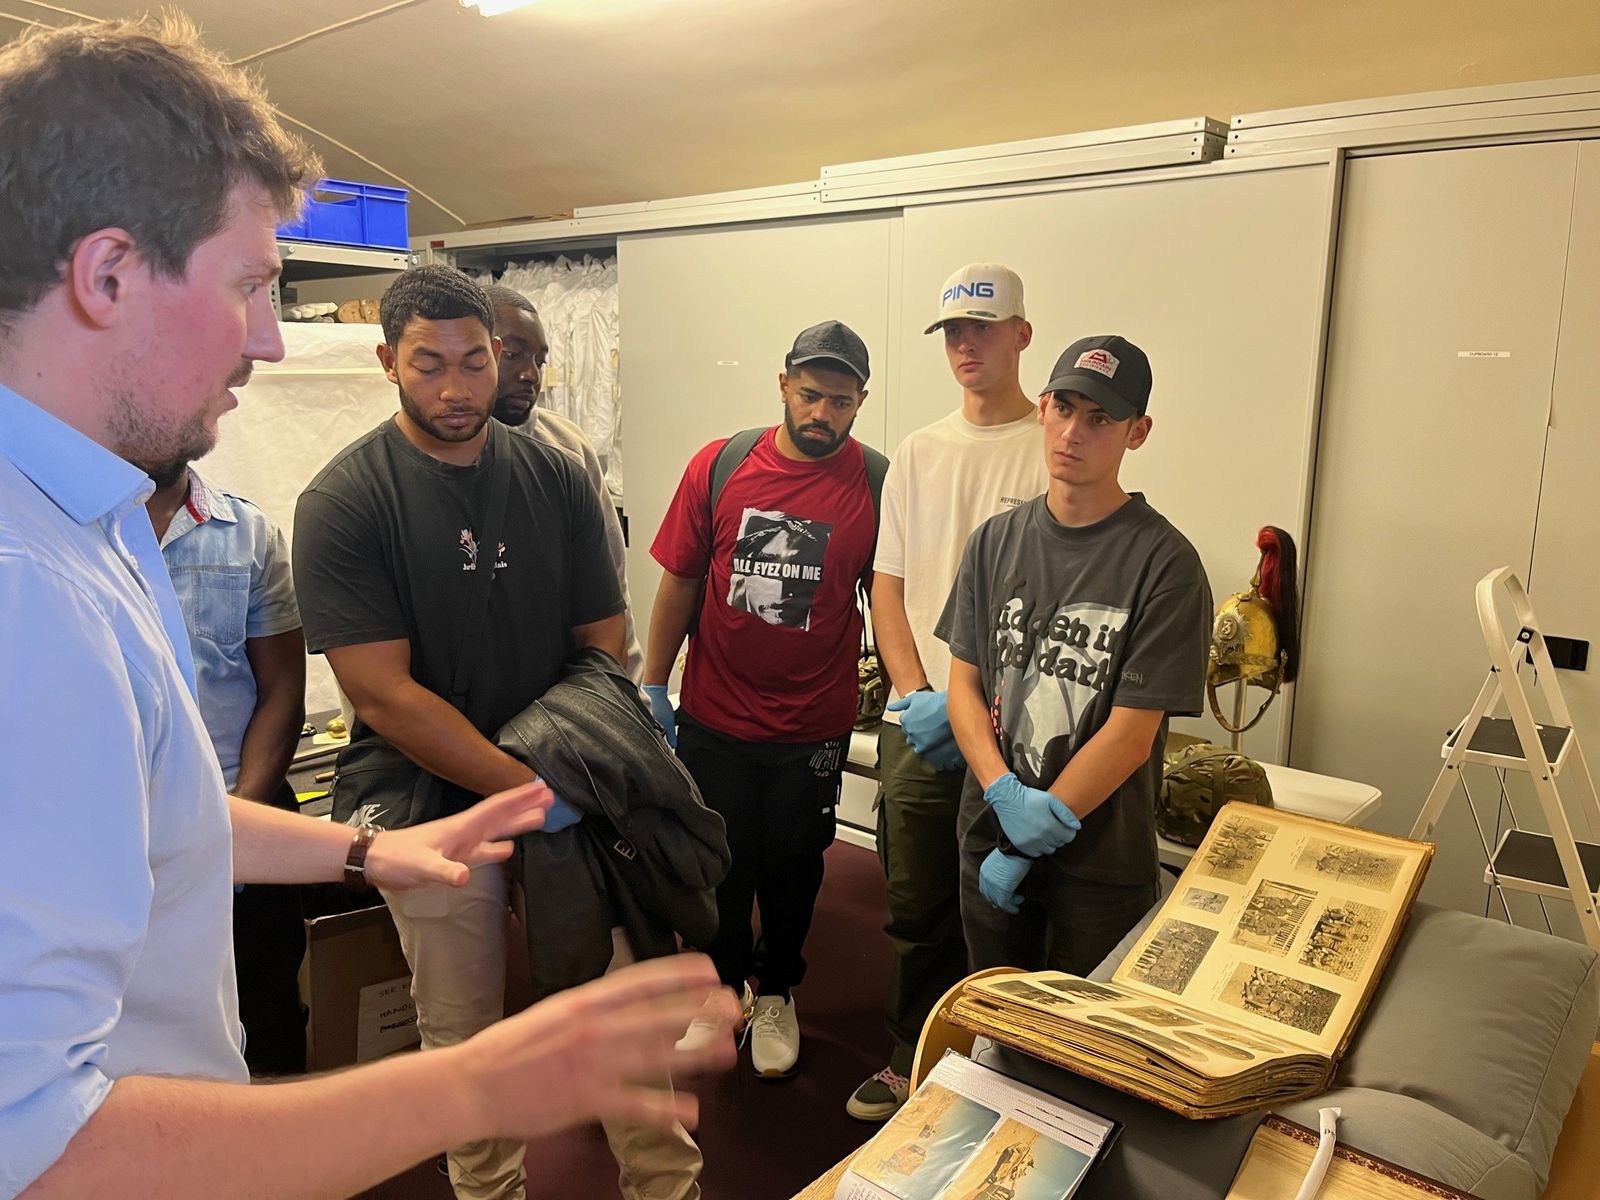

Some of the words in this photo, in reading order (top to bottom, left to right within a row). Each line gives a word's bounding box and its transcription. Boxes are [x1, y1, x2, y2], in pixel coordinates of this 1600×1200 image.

[942, 282, 993, 308] PING
[733, 558, 751, 573] ALL
[753, 561, 781, 577] EYEZ
[782, 563, 800, 579] ON
[802, 565, 822, 581] ME
[379, 1003, 413, 1018] HANDL
